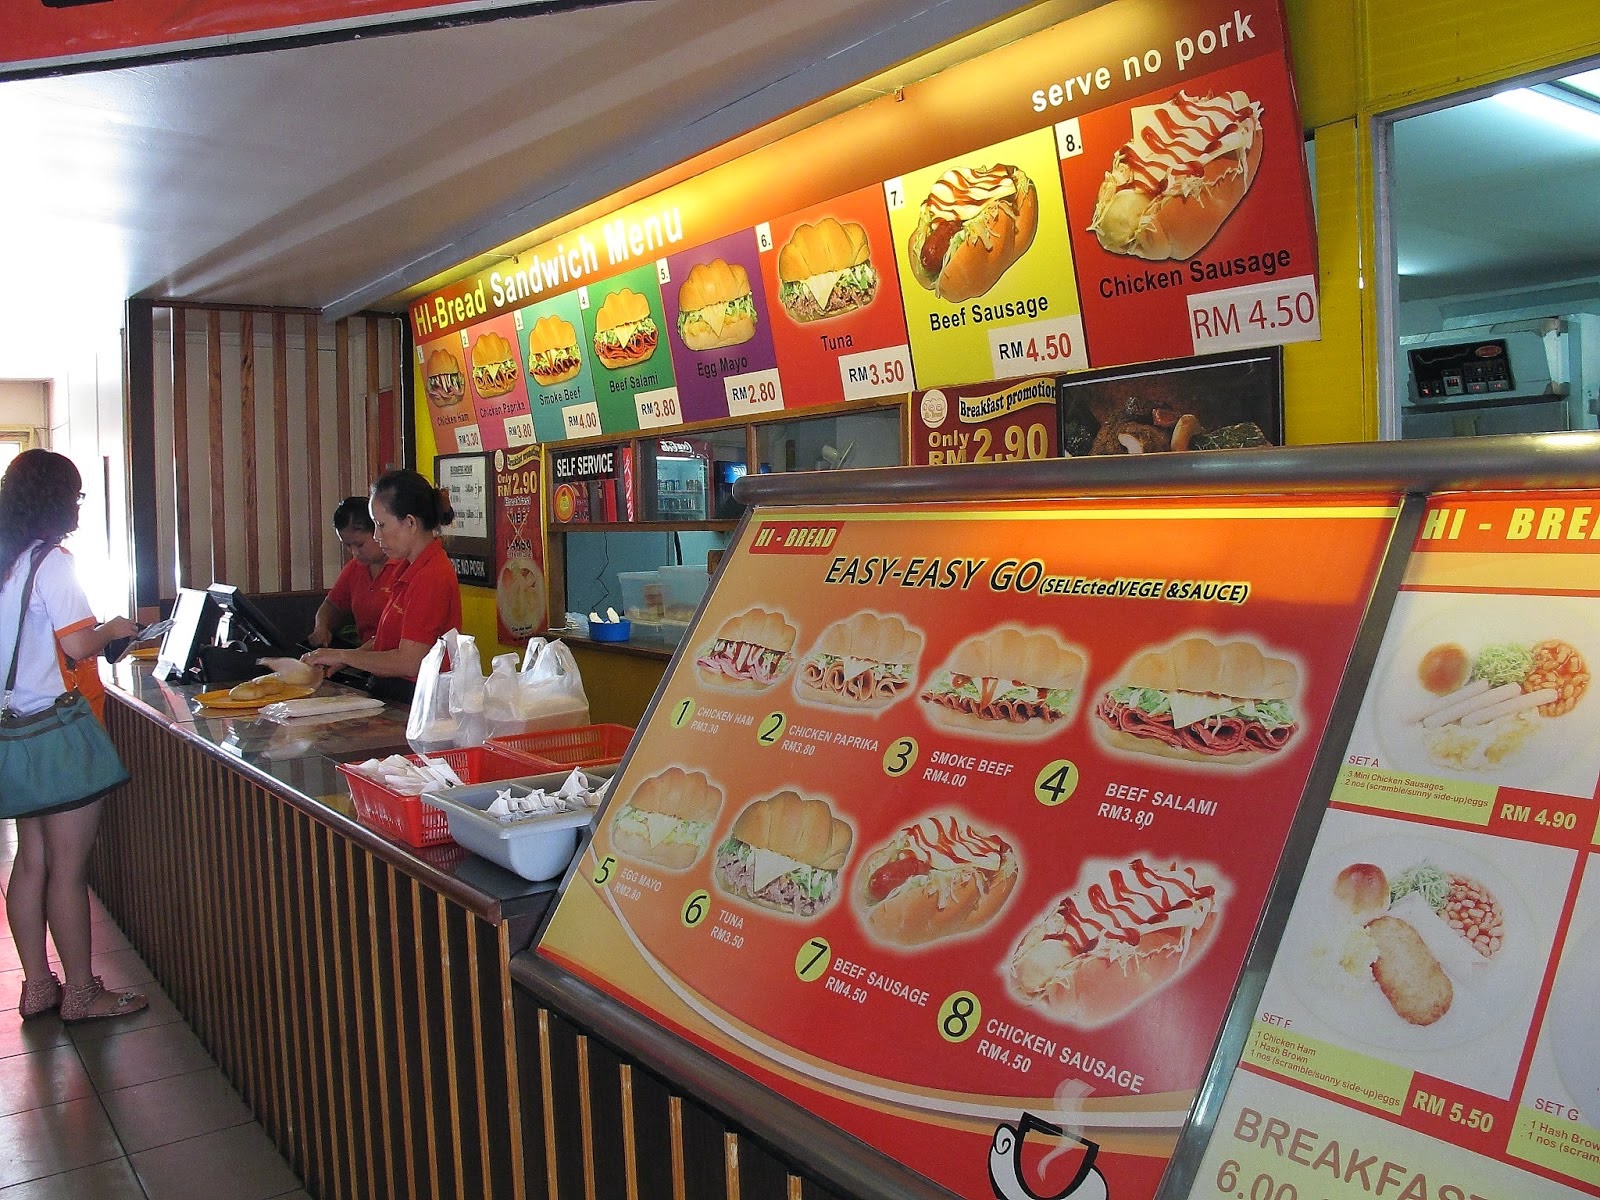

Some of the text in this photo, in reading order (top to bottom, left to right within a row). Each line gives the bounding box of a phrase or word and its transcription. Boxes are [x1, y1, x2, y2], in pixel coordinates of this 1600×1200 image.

[1032, 9, 1256, 113] serve no pork
[1066, 134, 1083, 152] 8.
[890, 191, 904, 207] 7.
[761, 234, 772, 247] 6.
[414, 206, 684, 337] HI-Bread Sandwich Menu
[1099, 249, 1292, 299] Chicken Sausage
[929, 295, 1049, 331] Beef Sausage
[1192, 291, 1315, 340] RM 4.50
[820, 333, 853, 352] Tuna
[696, 355, 748, 378] Egg Mayo
[609, 371, 659, 393] Beef Salami
[539, 387, 581, 405] Smoke Beef
[960, 394, 1004, 418] Breakfast
[479, 400, 526, 418] Chicken Paprika
[928, 429, 970, 449] Only
[973, 423, 1048, 463] 2.90
[556, 457, 576, 477] SELF
[577, 452, 614, 475] SERVICE
[928, 450, 966, 465] RM
[497, 473, 512, 484] Only
[497, 485, 512, 496] RM
[513, 470, 537, 494] 2.90
[1422, 508, 1468, 540] HI
[754, 527, 772, 548] HI
[784, 528, 837, 549] BREAD
[461, 559, 469, 575] NO
[470, 560, 485, 578] PORK
[824, 556, 988, 589] EASY-EASY
[989, 560, 1043, 593] GO
[673, 700, 690, 726] 1
[696, 706, 754, 727] CHICKEN HAM
[690, 719, 719, 735] RM3.30
[760, 713, 783, 742] 2
[788, 724, 879, 752] CHICKEN PAPRIKA
[781, 740, 816, 756] RM3.80
[886, 740, 914, 773] 3
[930, 750, 1014, 779] SMOKE BEEF
[1348, 754, 1380, 768] SET A
[922, 767, 967, 789] RM4.00
[1038, 764, 1073, 803] 4
[1344, 778, 1350, 786] 2
[1350, 780, 1366, 788] nos
[1353, 771, 1370, 780] Mini
[1371, 773, 1403, 786] Chicken
[1405, 778, 1444, 791] Sausages
[1104, 782, 1219, 818] BEEF SALAMI
[1096, 802, 1155, 830] RM3.80
[1500, 803, 1577, 831] RM 4.90
[595, 858, 615, 884] 5
[620, 867, 662, 892] EGG MAYO
[613, 882, 642, 902] RM2.80
[684, 894, 707, 925] 6
[719, 909, 744, 931] TUNA
[710, 926, 744, 950] RM3.50
[799, 940, 828, 976] 7
[824, 976, 868, 1004] RM4.50
[832, 957, 930, 1007] BEEF SAUSAGE
[943, 996, 975, 1038] 8
[1261, 1012, 1293, 1029] SET F
[976, 1038, 1032, 1074] RM4.50
[985, 1018, 1145, 1094] CHICKEN SAUSAGE
[1260, 1042, 1281, 1055] Hash
[1281, 1050, 1308, 1063] Brown
[1263, 1032, 1299, 1049] Chicken
[1297, 1044, 1316, 1056] Ham
[1256, 1052, 1271, 1061] nos
[1272, 1056, 1341, 1087] (scramble/sunny
[1341, 1079, 1401, 1106] side-up)eggs
[1412, 1090, 1494, 1134] RM 5.50
[1534, 1098, 1579, 1121] SET G
[1540, 1122, 1568, 1140] Hash
[1233, 1107, 1491, 1200] BREAKFA
[1536, 1135, 1556, 1149] nos
[1559, 1142, 1600, 1165] (scram
